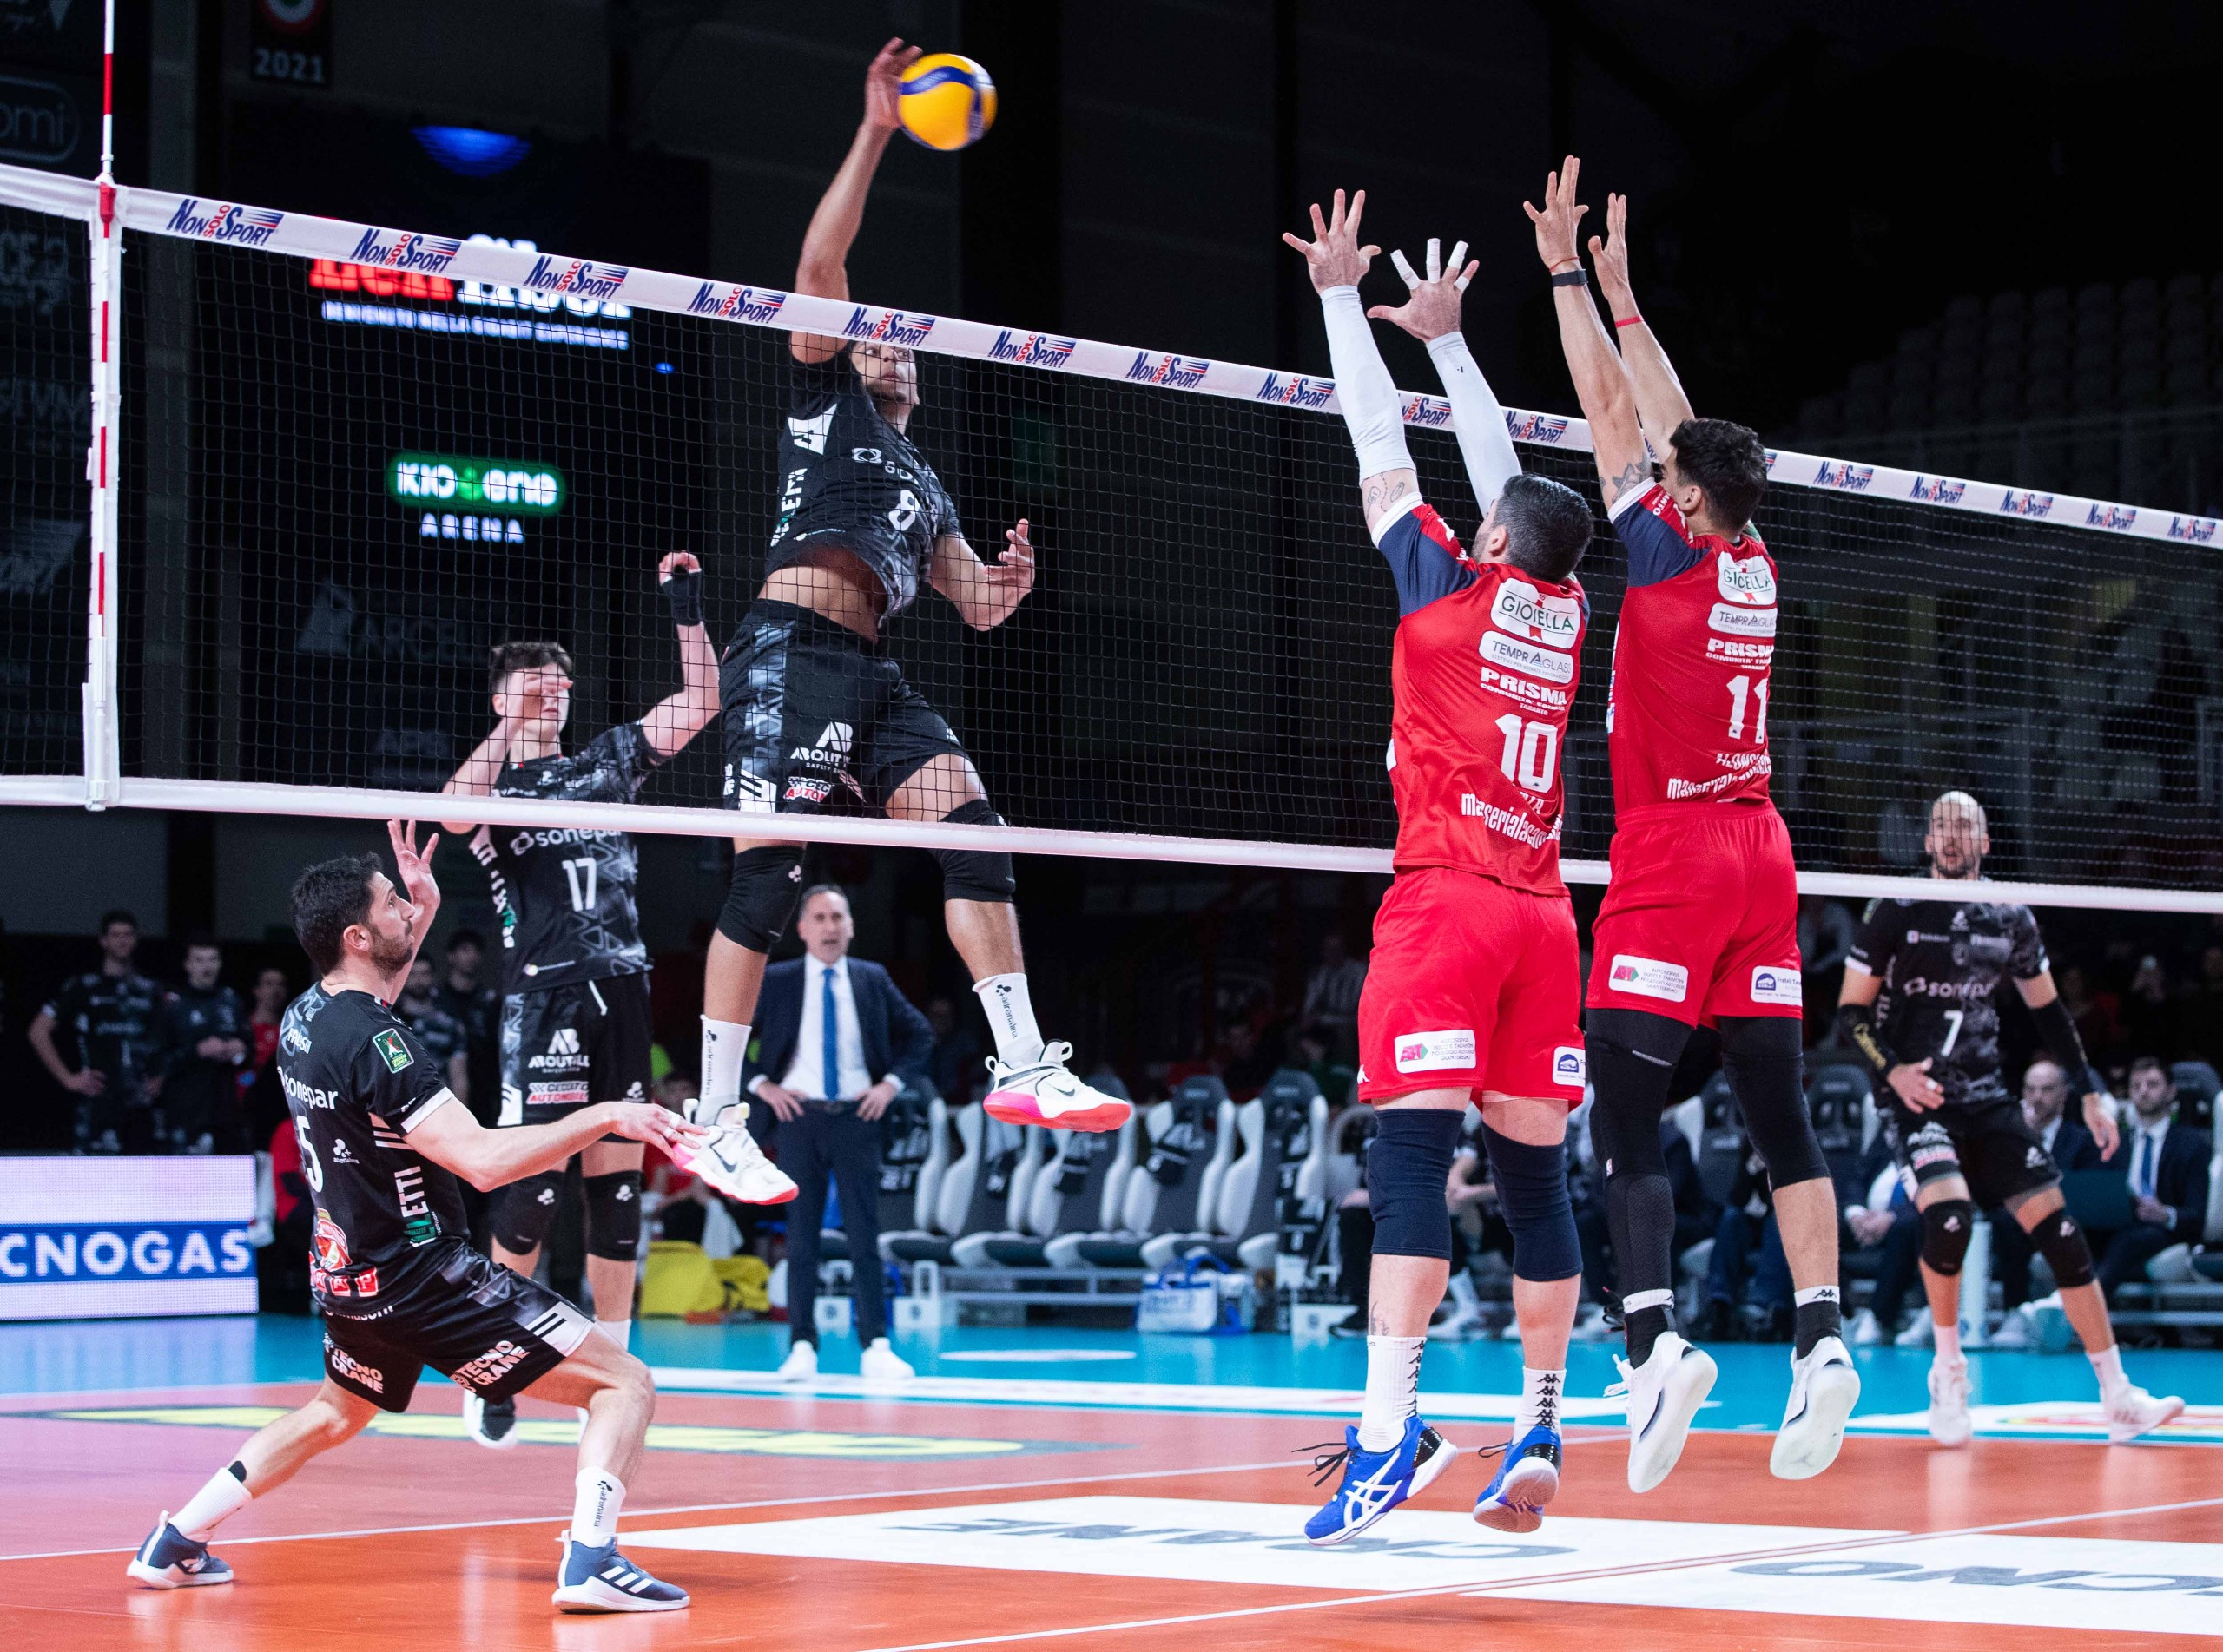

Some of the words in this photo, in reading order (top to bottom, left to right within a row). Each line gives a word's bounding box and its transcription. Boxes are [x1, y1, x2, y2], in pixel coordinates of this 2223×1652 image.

[254, 48, 327, 83] 2021
[203, 205, 231, 238] SOLO
[387, 234, 412, 267] SOLO
[557, 260, 582, 293] SOLO
[718, 286, 742, 317] SOLO
[420, 513, 524, 543] ARENA
[1501, 596, 1574, 632] GIOIELLA
[1481, 667, 1567, 705] PRISMA
[1726, 675, 1768, 744] 11
[1494, 713, 1558, 793] 10
[562, 856, 597, 912] 17
[1943, 1010, 1963, 1056] 7
[284, 1076, 338, 1109] sonepar
[296, 1115, 324, 1192] 5
[0, 1229, 252, 1277] CNOGAS
[332, 1354, 384, 1394] CRANE
[333, 1348, 383, 1382] TECNO
[455, 1340, 514, 1379] TECNO
[473, 1346, 531, 1386] CRANE
[1728, 1561, 2223, 1596] CNO
